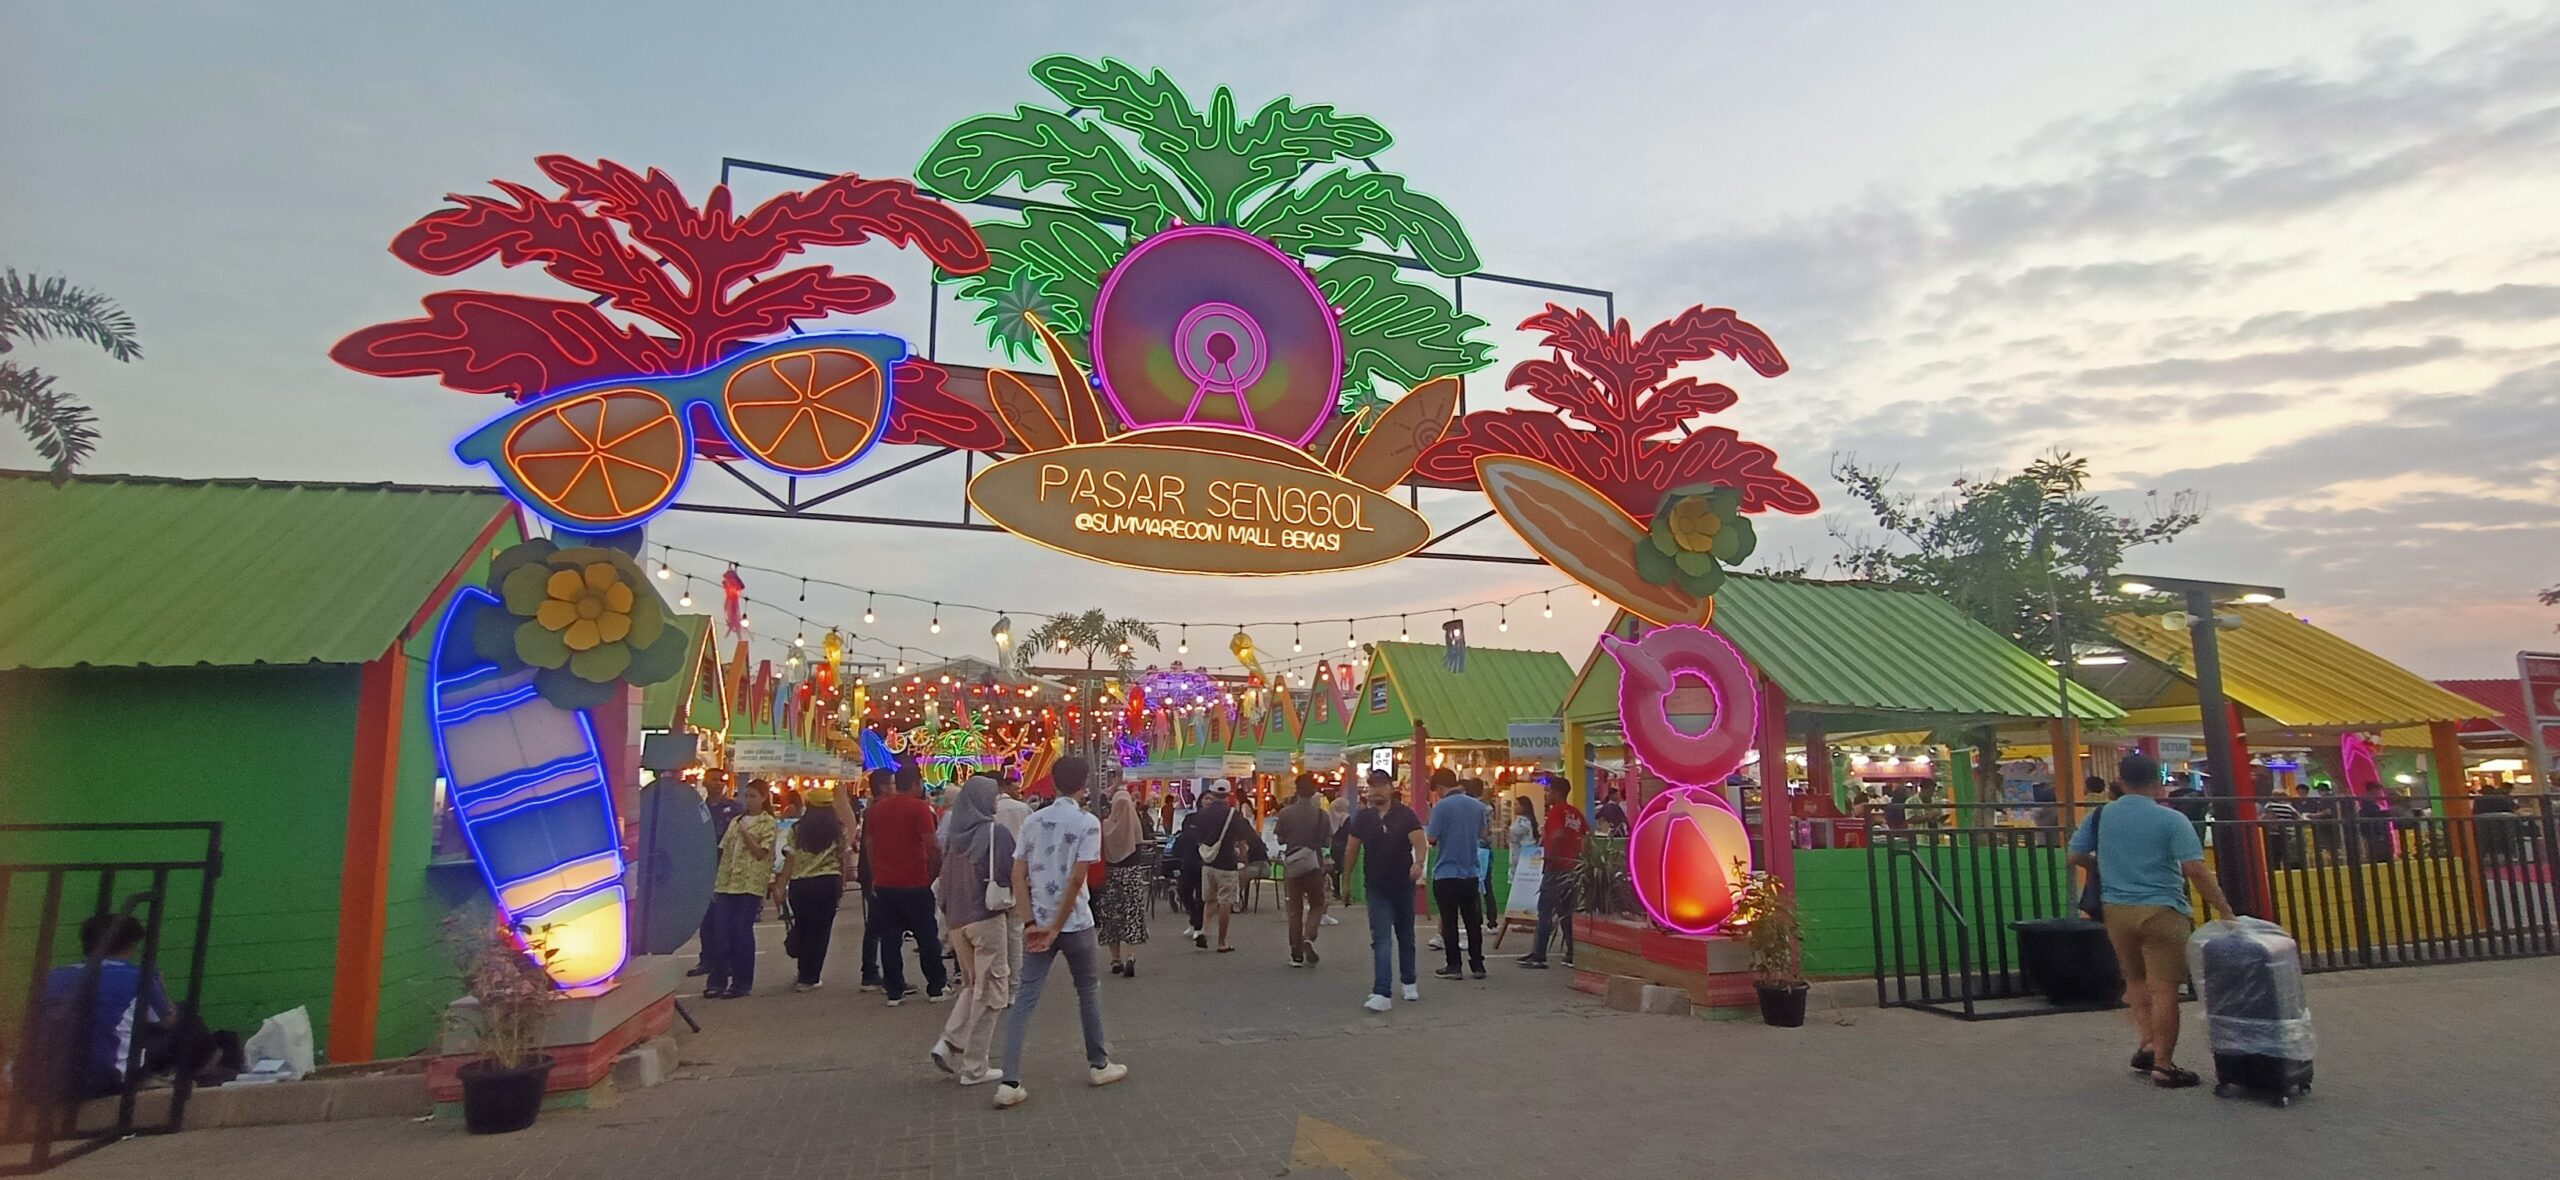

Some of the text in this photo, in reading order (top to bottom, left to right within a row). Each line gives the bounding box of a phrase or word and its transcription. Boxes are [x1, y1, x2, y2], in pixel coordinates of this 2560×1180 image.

[1040, 464, 1375, 532] PASAR SENGGOL
[1074, 512, 1340, 552] @SUMMARECON MALL BEKASI
[1510, 736, 1560, 748] MAYORA
